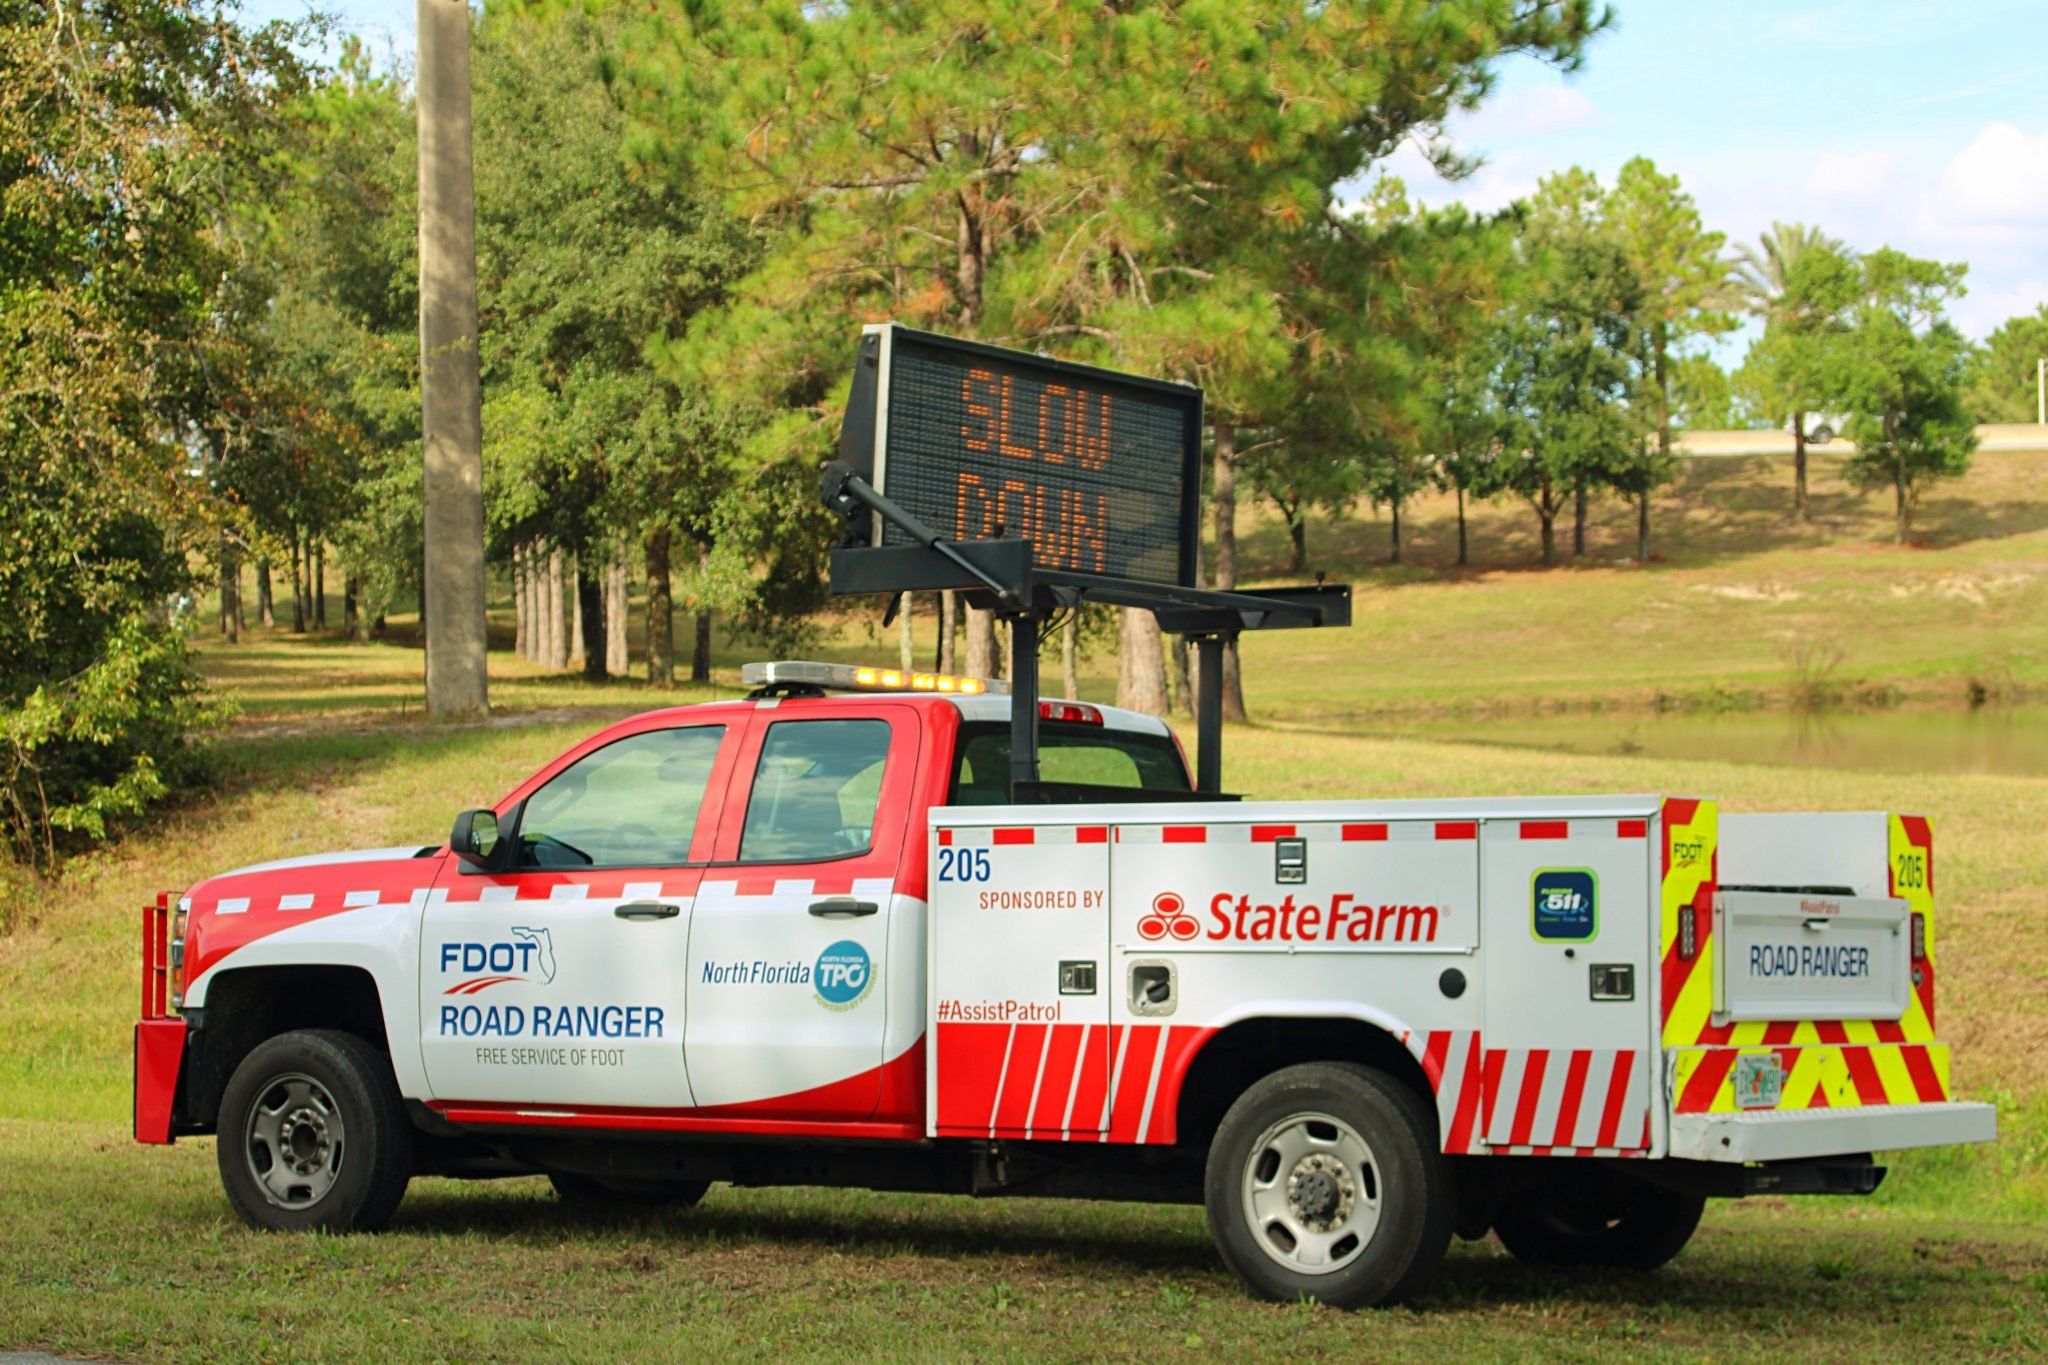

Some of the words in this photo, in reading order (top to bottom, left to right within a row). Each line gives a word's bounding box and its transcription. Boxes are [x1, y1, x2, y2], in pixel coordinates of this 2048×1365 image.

[961, 369, 1112, 470] SLOW
[956, 472, 1106, 572] DOWN
[1674, 843, 1703, 859] FDOT
[938, 848, 991, 882] 205
[1898, 854, 1923, 888] 205
[979, 891, 1077, 909] SPONSORED
[1083, 890, 1104, 908] BY
[1547, 893, 1581, 910] 511
[440, 943, 538, 972] FDOT
[1750, 945, 1797, 976] ROAD
[1801, 946, 1869, 977] RANGER
[702, 961, 748, 984] North
[751, 961, 810, 984] Florida
[820, 964, 866, 988] TPO
[440, 1005, 525, 1037] ROAD
[532, 1006, 664, 1038] RANGER
[937, 1000, 1061, 1021] #AssistPatrol
[476, 1048, 508, 1065] FREE
[511, 1048, 566, 1066] SERVICE
[570, 1049, 587, 1066] OF
[591, 1049, 625, 1066] FDOT
